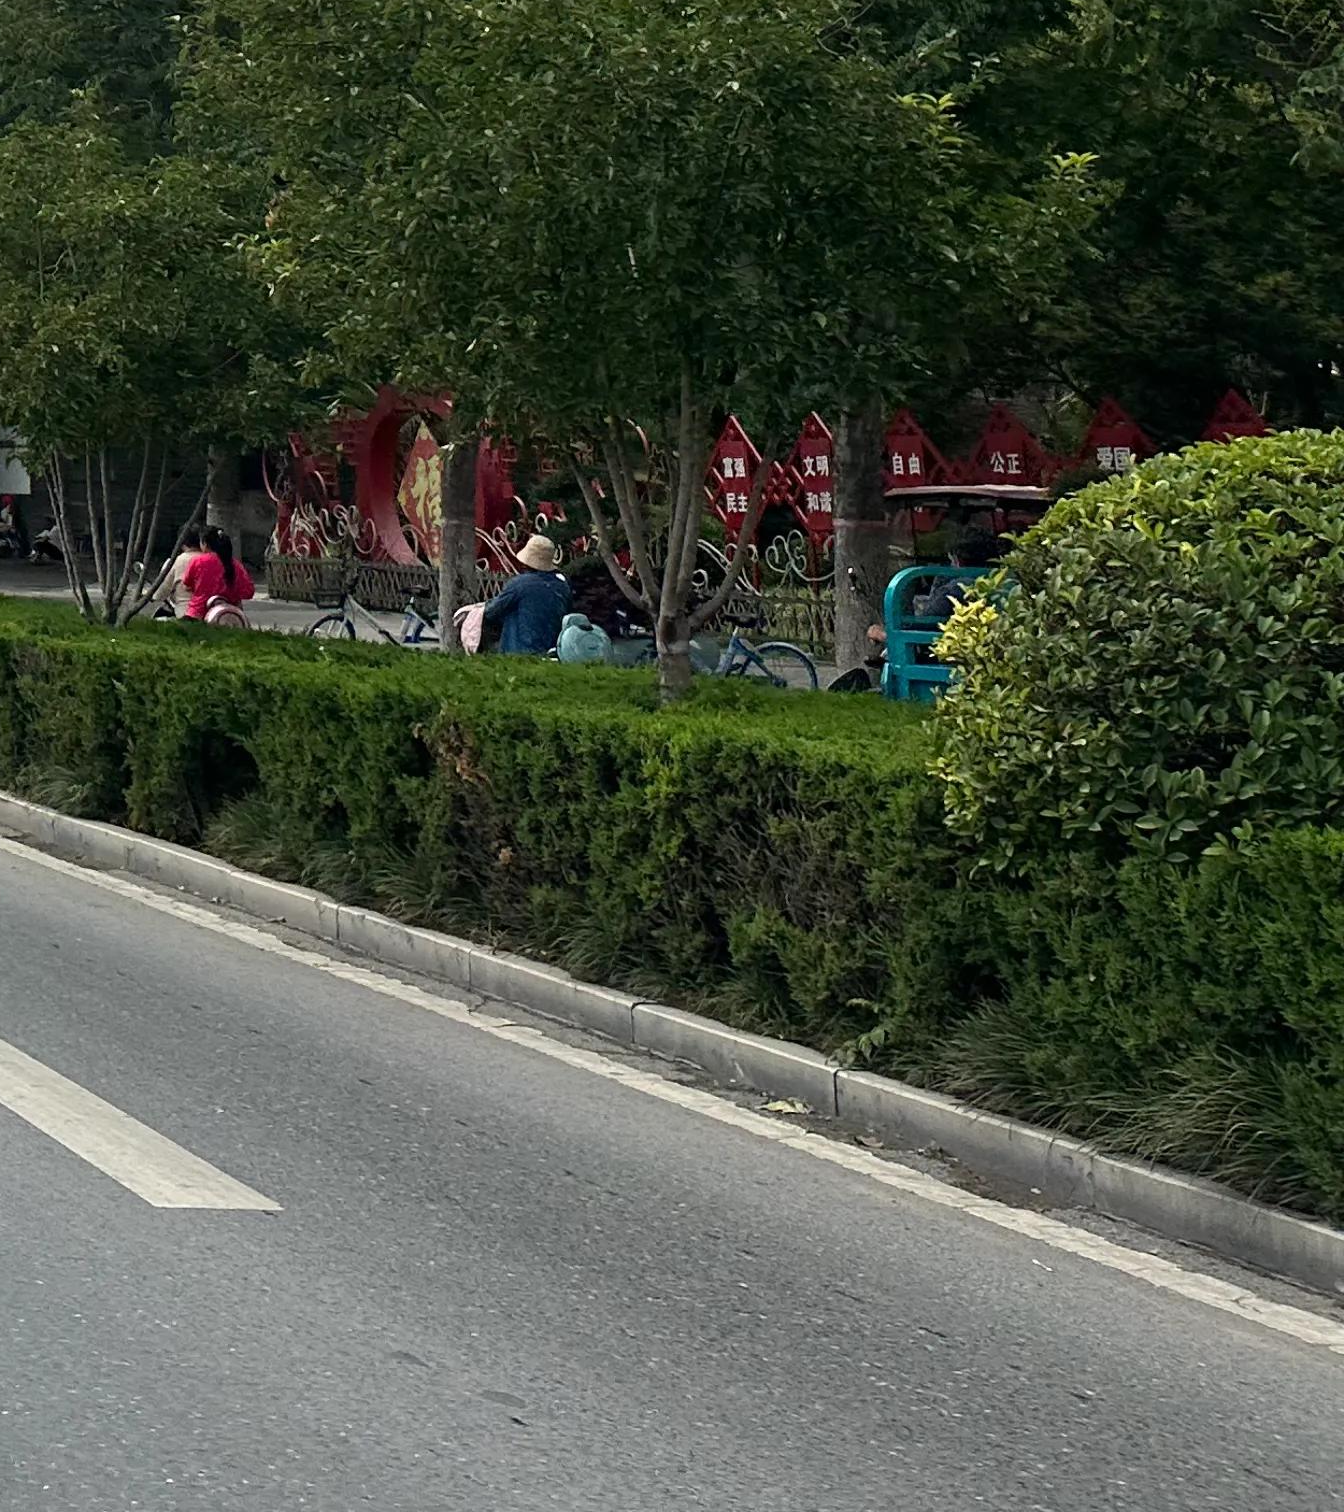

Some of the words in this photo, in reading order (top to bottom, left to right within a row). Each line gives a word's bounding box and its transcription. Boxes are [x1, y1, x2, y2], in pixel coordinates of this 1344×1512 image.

[722, 456, 746, 478] 富强
[802, 454, 830, 477] 文明
[892, 452, 921, 476] 自由
[990, 450, 1022, 475] 公正
[1096, 447, 1131, 472] 爱国
[725, 492, 749, 513] 民主
[805, 491, 832, 513] 和谐
